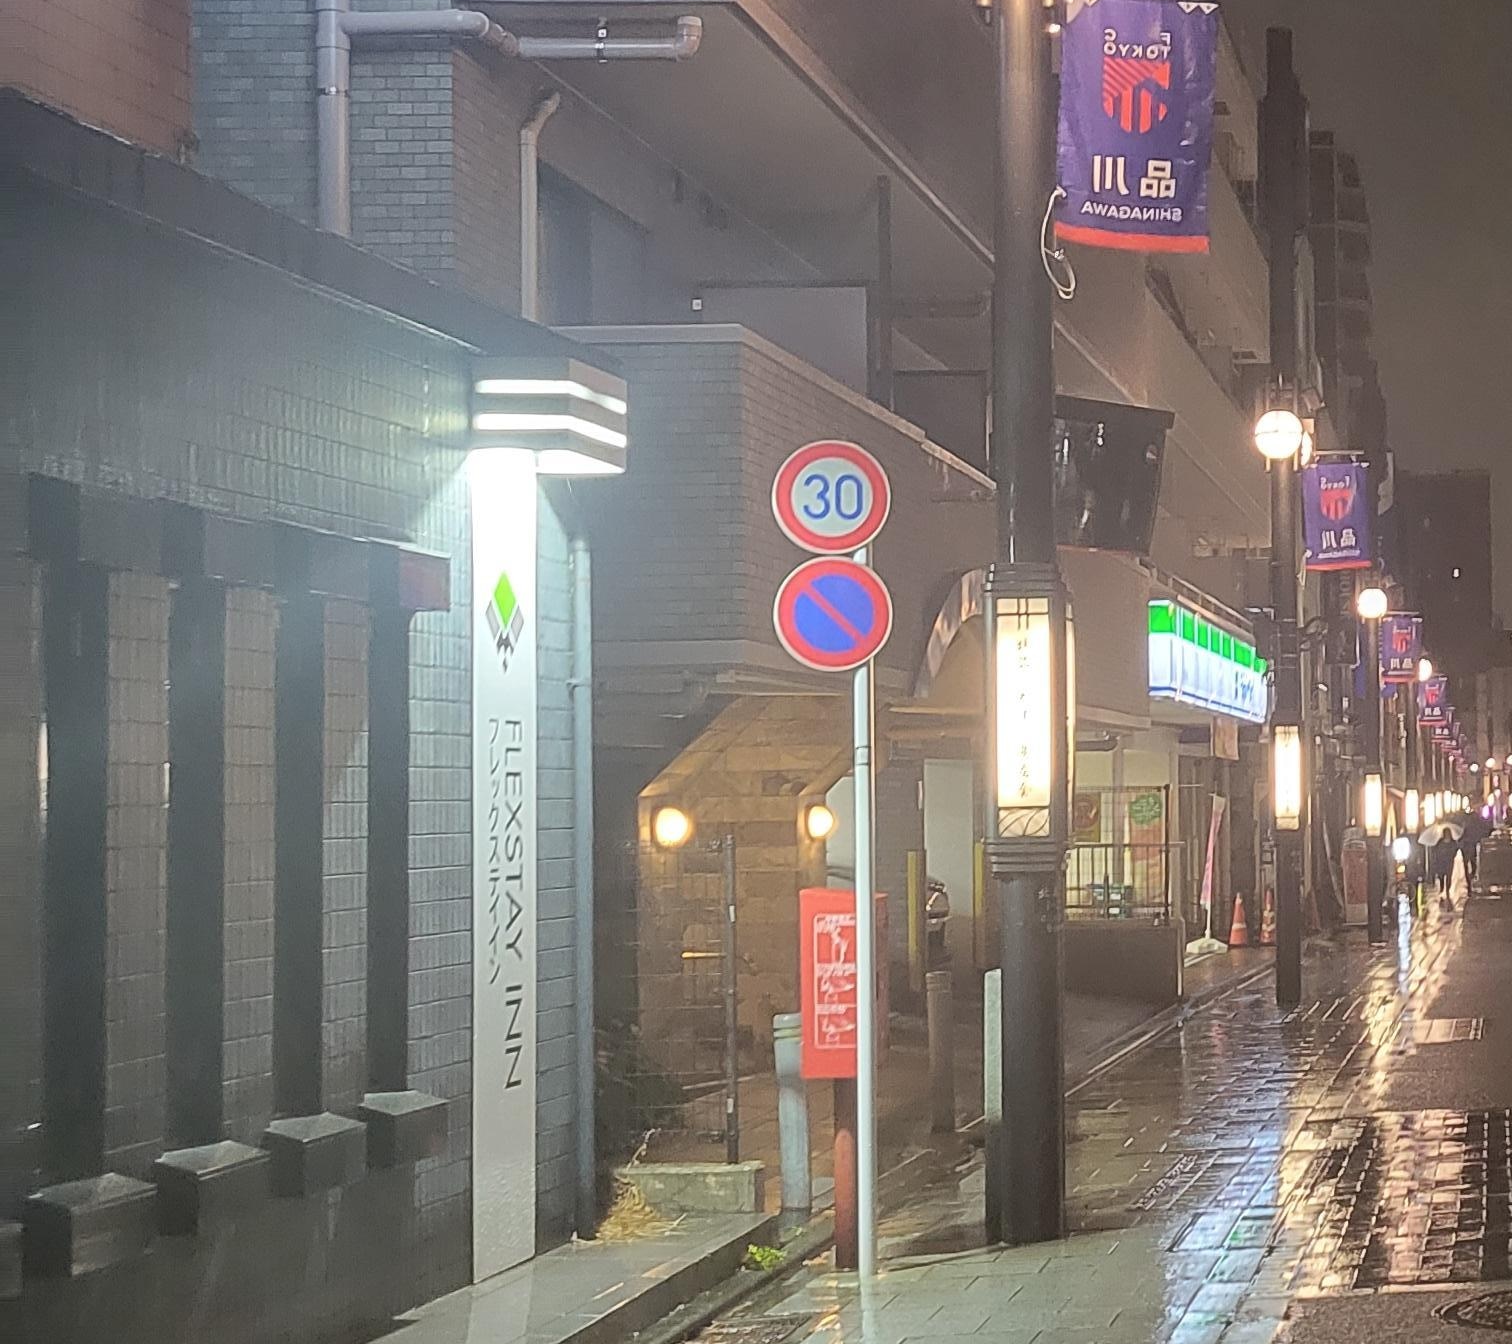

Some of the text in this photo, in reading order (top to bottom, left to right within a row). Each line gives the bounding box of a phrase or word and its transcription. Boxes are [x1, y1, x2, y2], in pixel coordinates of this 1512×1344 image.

[803, 474, 864, 521] 30
[488, 718, 501, 986] フレックステイイン
[504, 719, 524, 1090] FLEXSTAY INN
